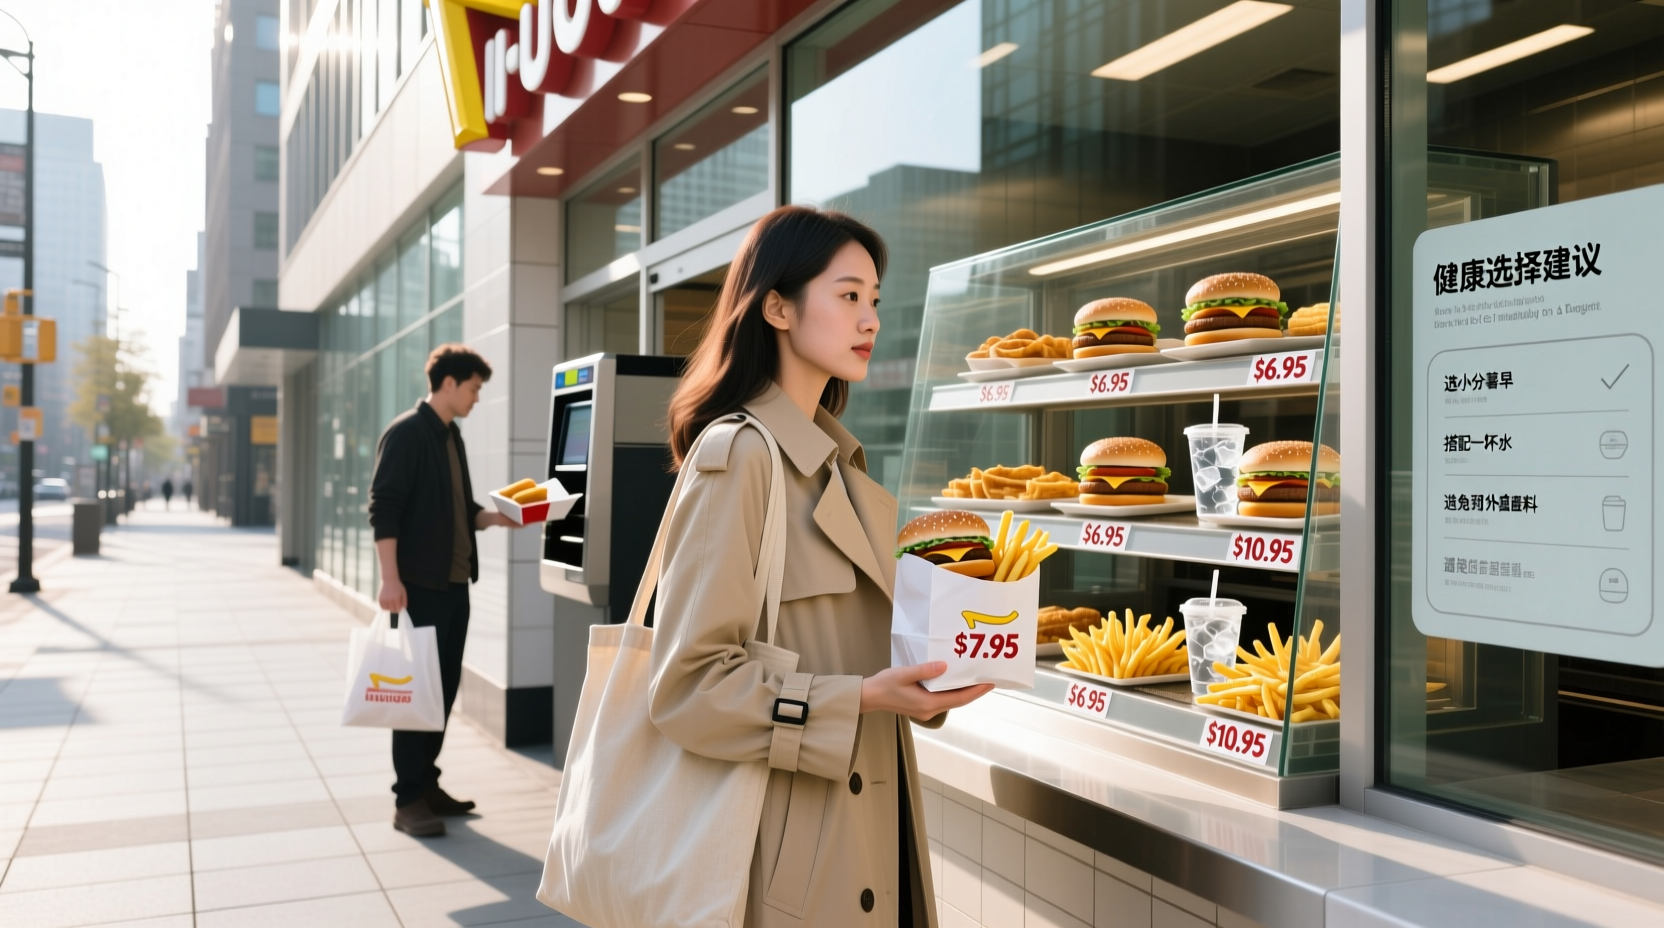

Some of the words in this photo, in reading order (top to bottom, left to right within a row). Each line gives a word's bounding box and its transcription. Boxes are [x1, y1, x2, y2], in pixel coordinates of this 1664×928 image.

[1433, 242, 1602, 296] 健康选择建议
[1253, 355, 1308, 383] $6.95
[979, 385, 1010, 403] $6.95
[1089, 372, 1130, 395] $6.95
[1082, 523, 1125, 547] $6.95
[1232, 533, 1295, 564] $10.95
[954, 631, 1019, 659] $7.95
[1206, 720, 1267, 758] $10.95
